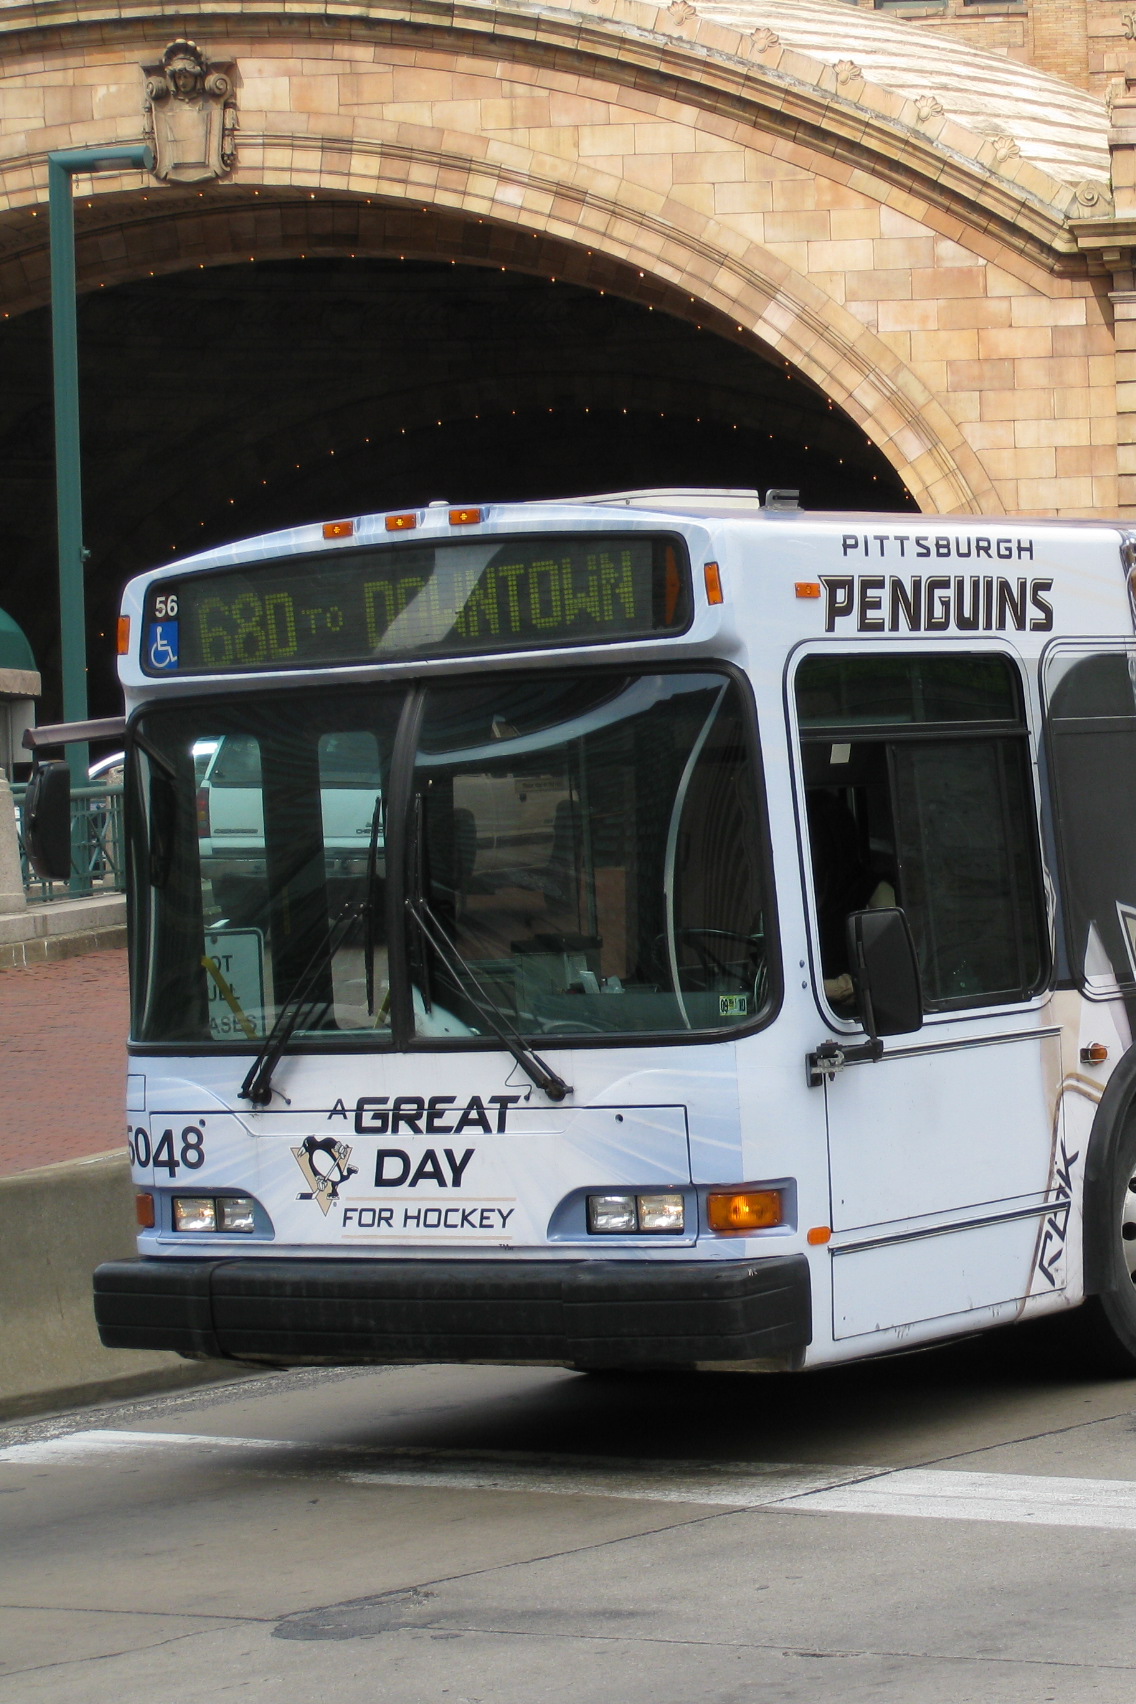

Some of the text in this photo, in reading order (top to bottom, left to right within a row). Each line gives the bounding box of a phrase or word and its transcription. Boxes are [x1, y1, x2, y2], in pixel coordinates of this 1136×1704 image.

[842, 534, 1034, 561] PITTSBURGH
[155, 595, 178, 617] 56
[363, 551, 635, 648] DOWNTOWN
[817, 575, 1054, 632] PENGUINS
[327, 1095, 521, 1134] A GREAT
[374, 1148, 476, 1187] DAY
[342, 1207, 515, 1228] FOR HOCKEY
